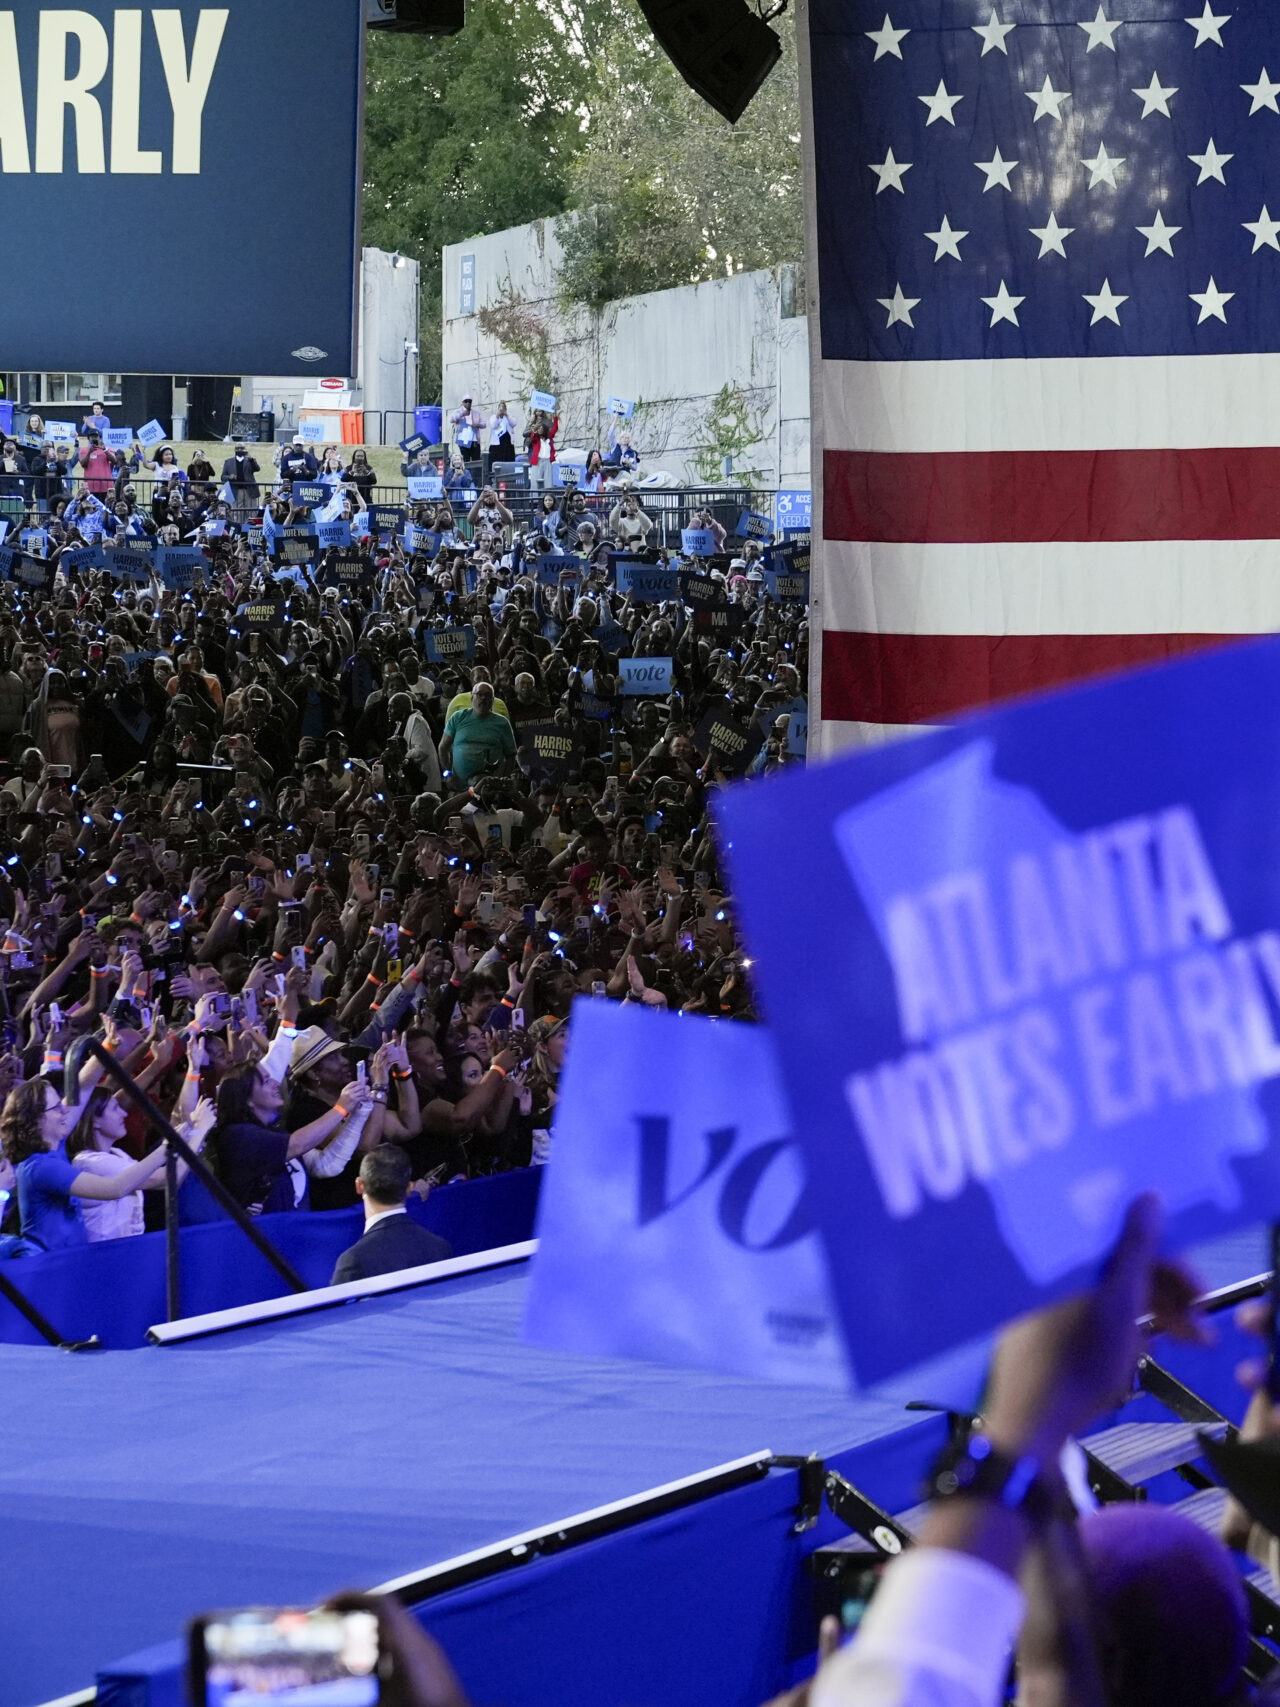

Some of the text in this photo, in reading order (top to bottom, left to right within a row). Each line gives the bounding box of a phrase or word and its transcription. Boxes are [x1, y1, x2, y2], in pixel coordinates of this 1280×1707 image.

[299, 487, 323, 497] HARRIS
[375, 512, 399, 523] HARRIS
[780, 515, 801, 527] KEEP
[379, 520, 396, 528] WALZ
[319, 527, 344, 537] HARRIS
[129, 540, 152, 549] HARRIS
[113, 553, 143, 566] HARRIS
[335, 562, 364, 573] HARRIS
[543, 560, 575, 574] vote
[640, 577, 673, 591] vote
[687, 579, 715, 595] HARRIS
[244, 605, 275, 615] HARRIS
[248, 614, 270, 622] WALZ
[433, 632, 452, 644] VOTE
[434, 642, 468, 654] FREEDOM
[626, 664, 666, 682] vote
[709, 721, 747, 752] HARRIS
[534, 735, 573, 752] HARRIS
[710, 736, 737, 756] WALZ
[539, 748, 567, 759] WALZ
[880, 803, 1234, 1048] ATLANTA
[844, 1005, 1078, 1222] VOTES
[630, 1113, 810, 1253] vo
